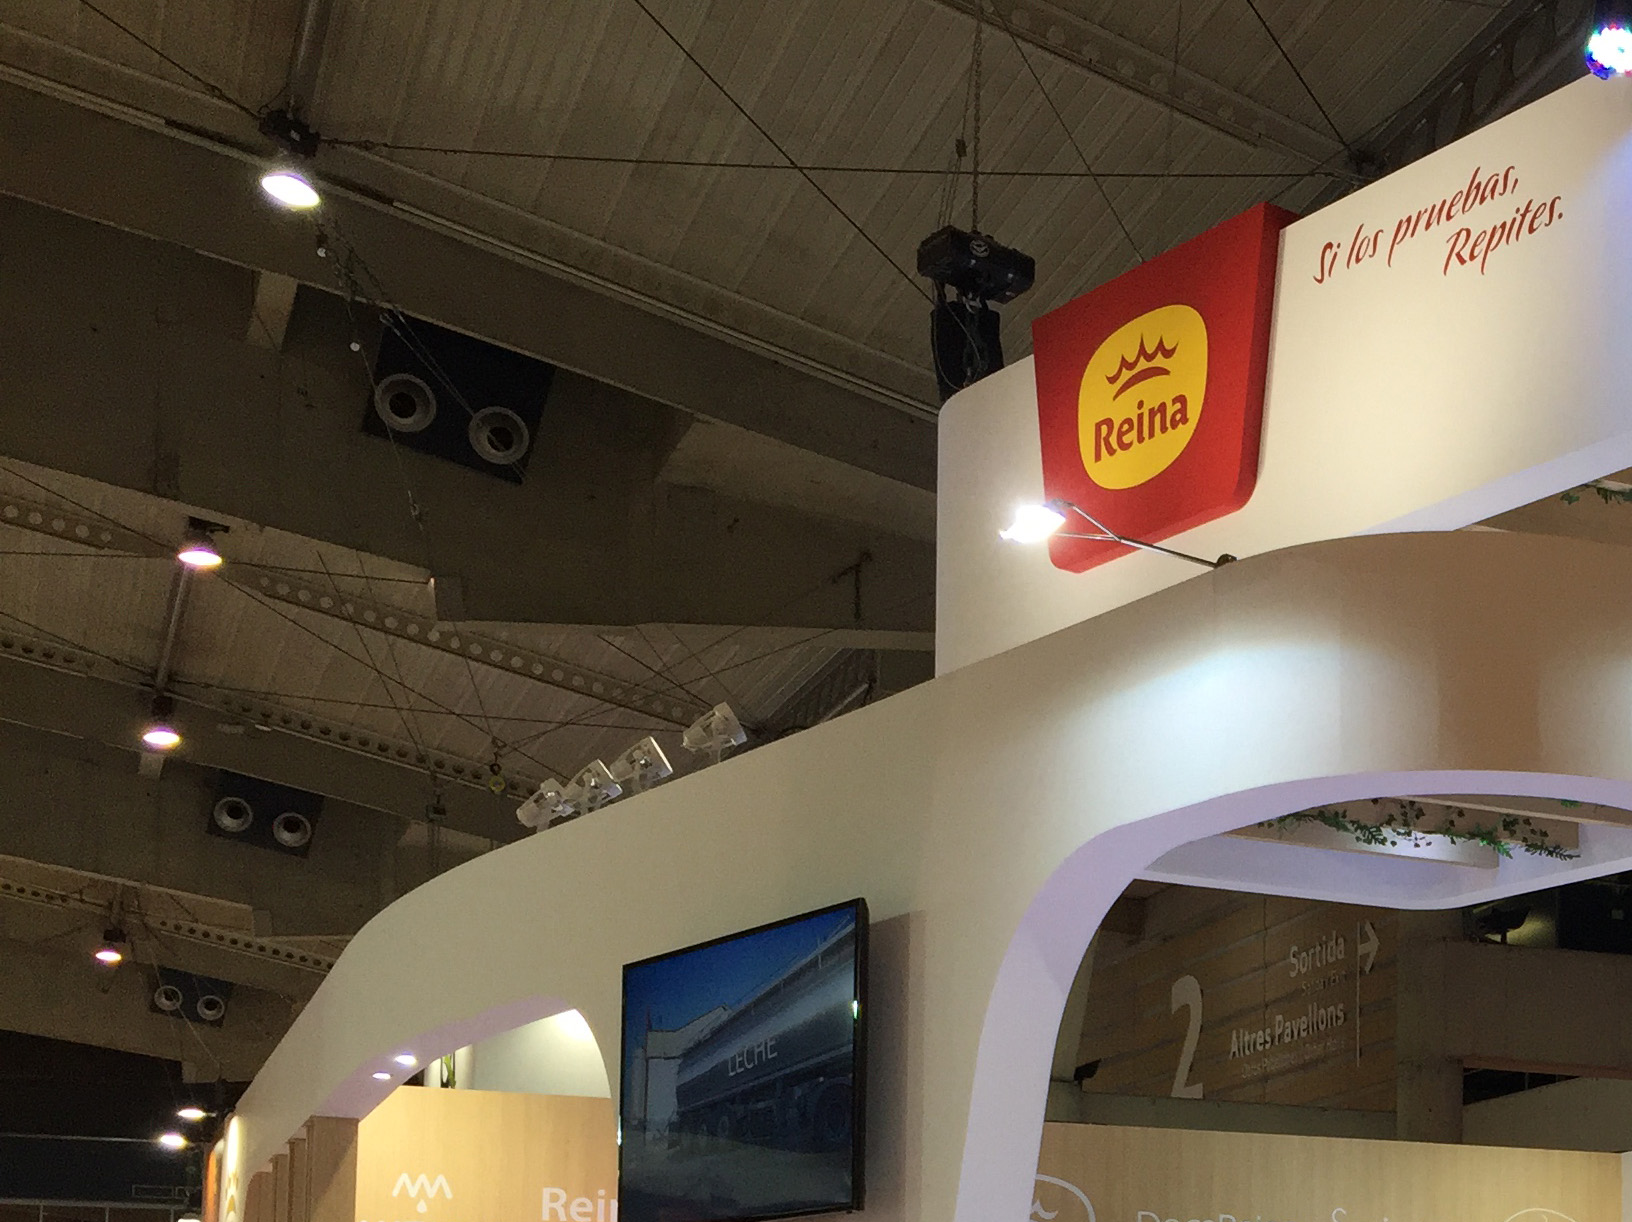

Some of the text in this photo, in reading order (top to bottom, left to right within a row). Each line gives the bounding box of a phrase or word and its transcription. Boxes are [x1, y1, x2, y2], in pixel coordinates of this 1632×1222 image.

[1313, 165, 1519, 284] Si los pruebas,
[1443, 195, 1563, 276] Repites.
[1094, 393, 1189, 464] Reina
[1289, 930, 1345, 978] Sortida
[727, 1036, 778, 1077] LECHE
[1171, 974, 1203, 1099] 2
[1229, 1029, 1271, 1060] Altres
[1275, 1002, 1345, 1045] Pavellons
